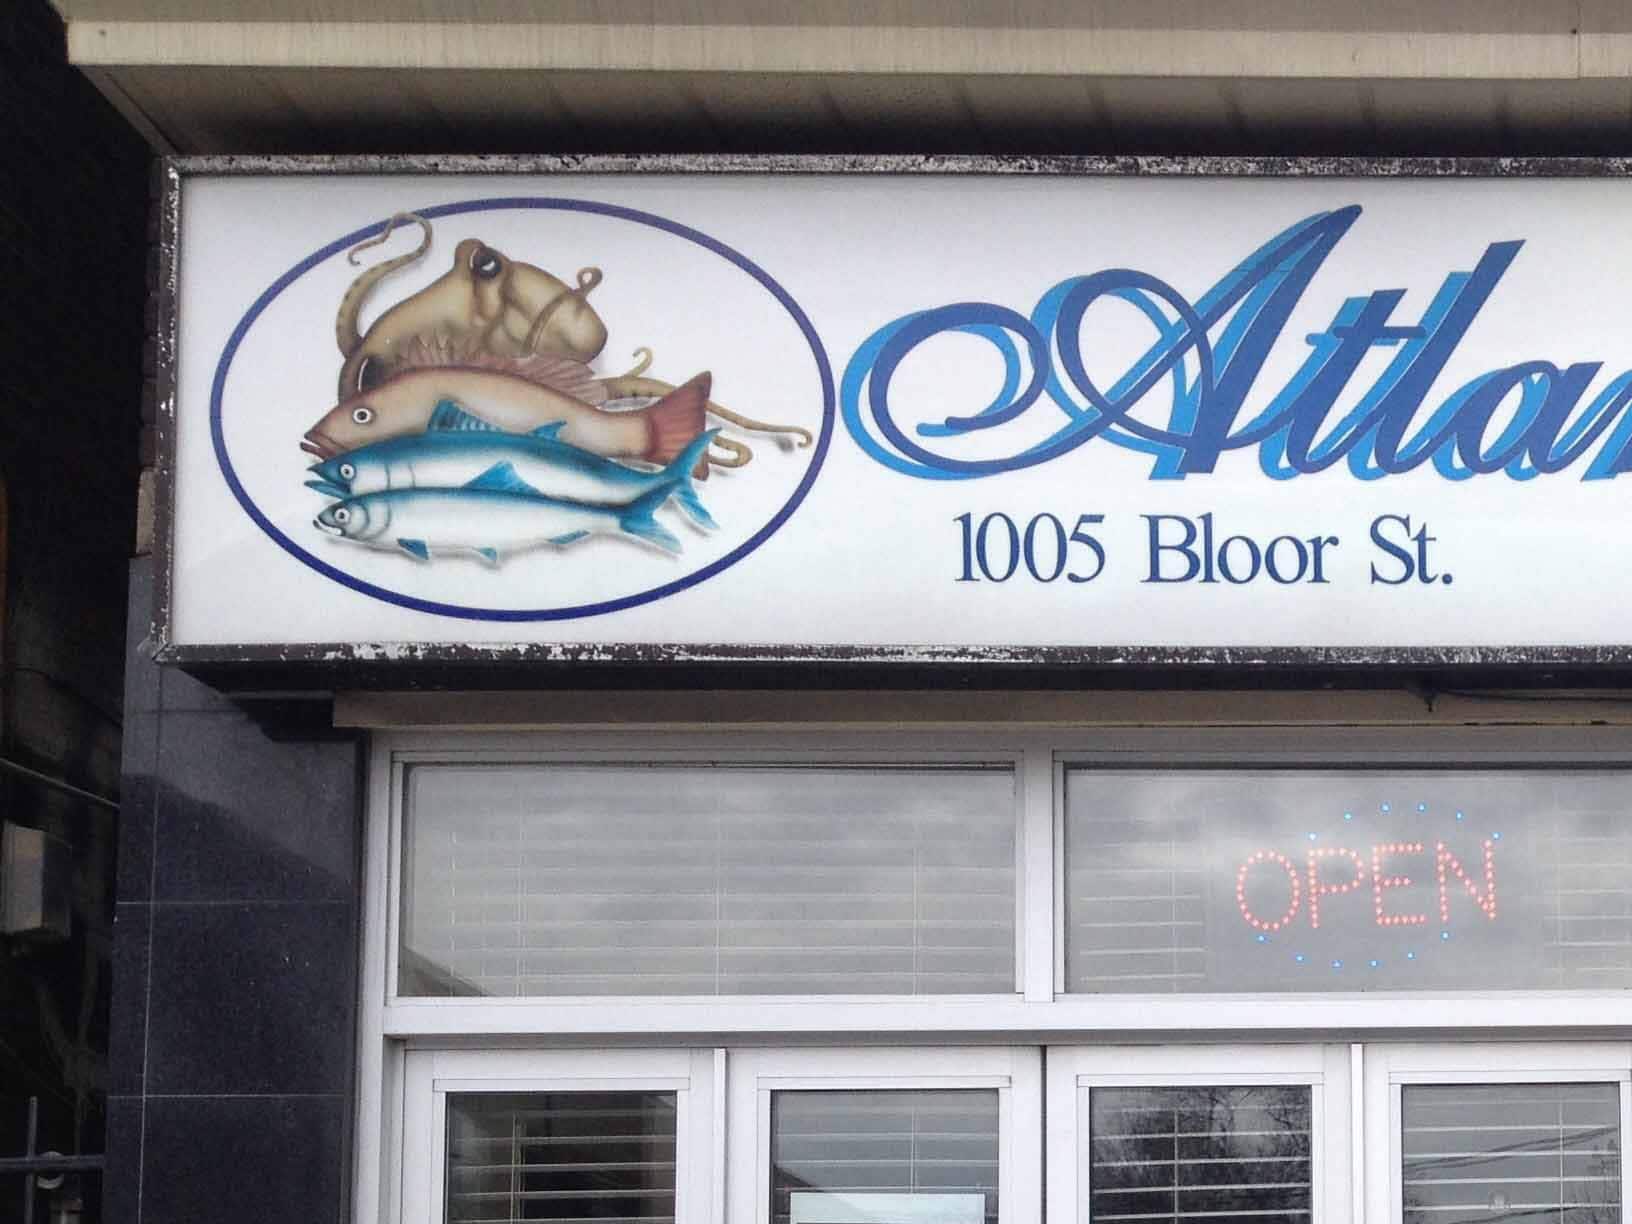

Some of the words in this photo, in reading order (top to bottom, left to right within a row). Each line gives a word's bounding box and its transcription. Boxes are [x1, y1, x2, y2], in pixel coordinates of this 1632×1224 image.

[952, 511, 1106, 584] 1005
[1140, 511, 1339, 584] Bloor
[1369, 513, 1454, 585] St.
[1236, 839, 1497, 932] OPEN
